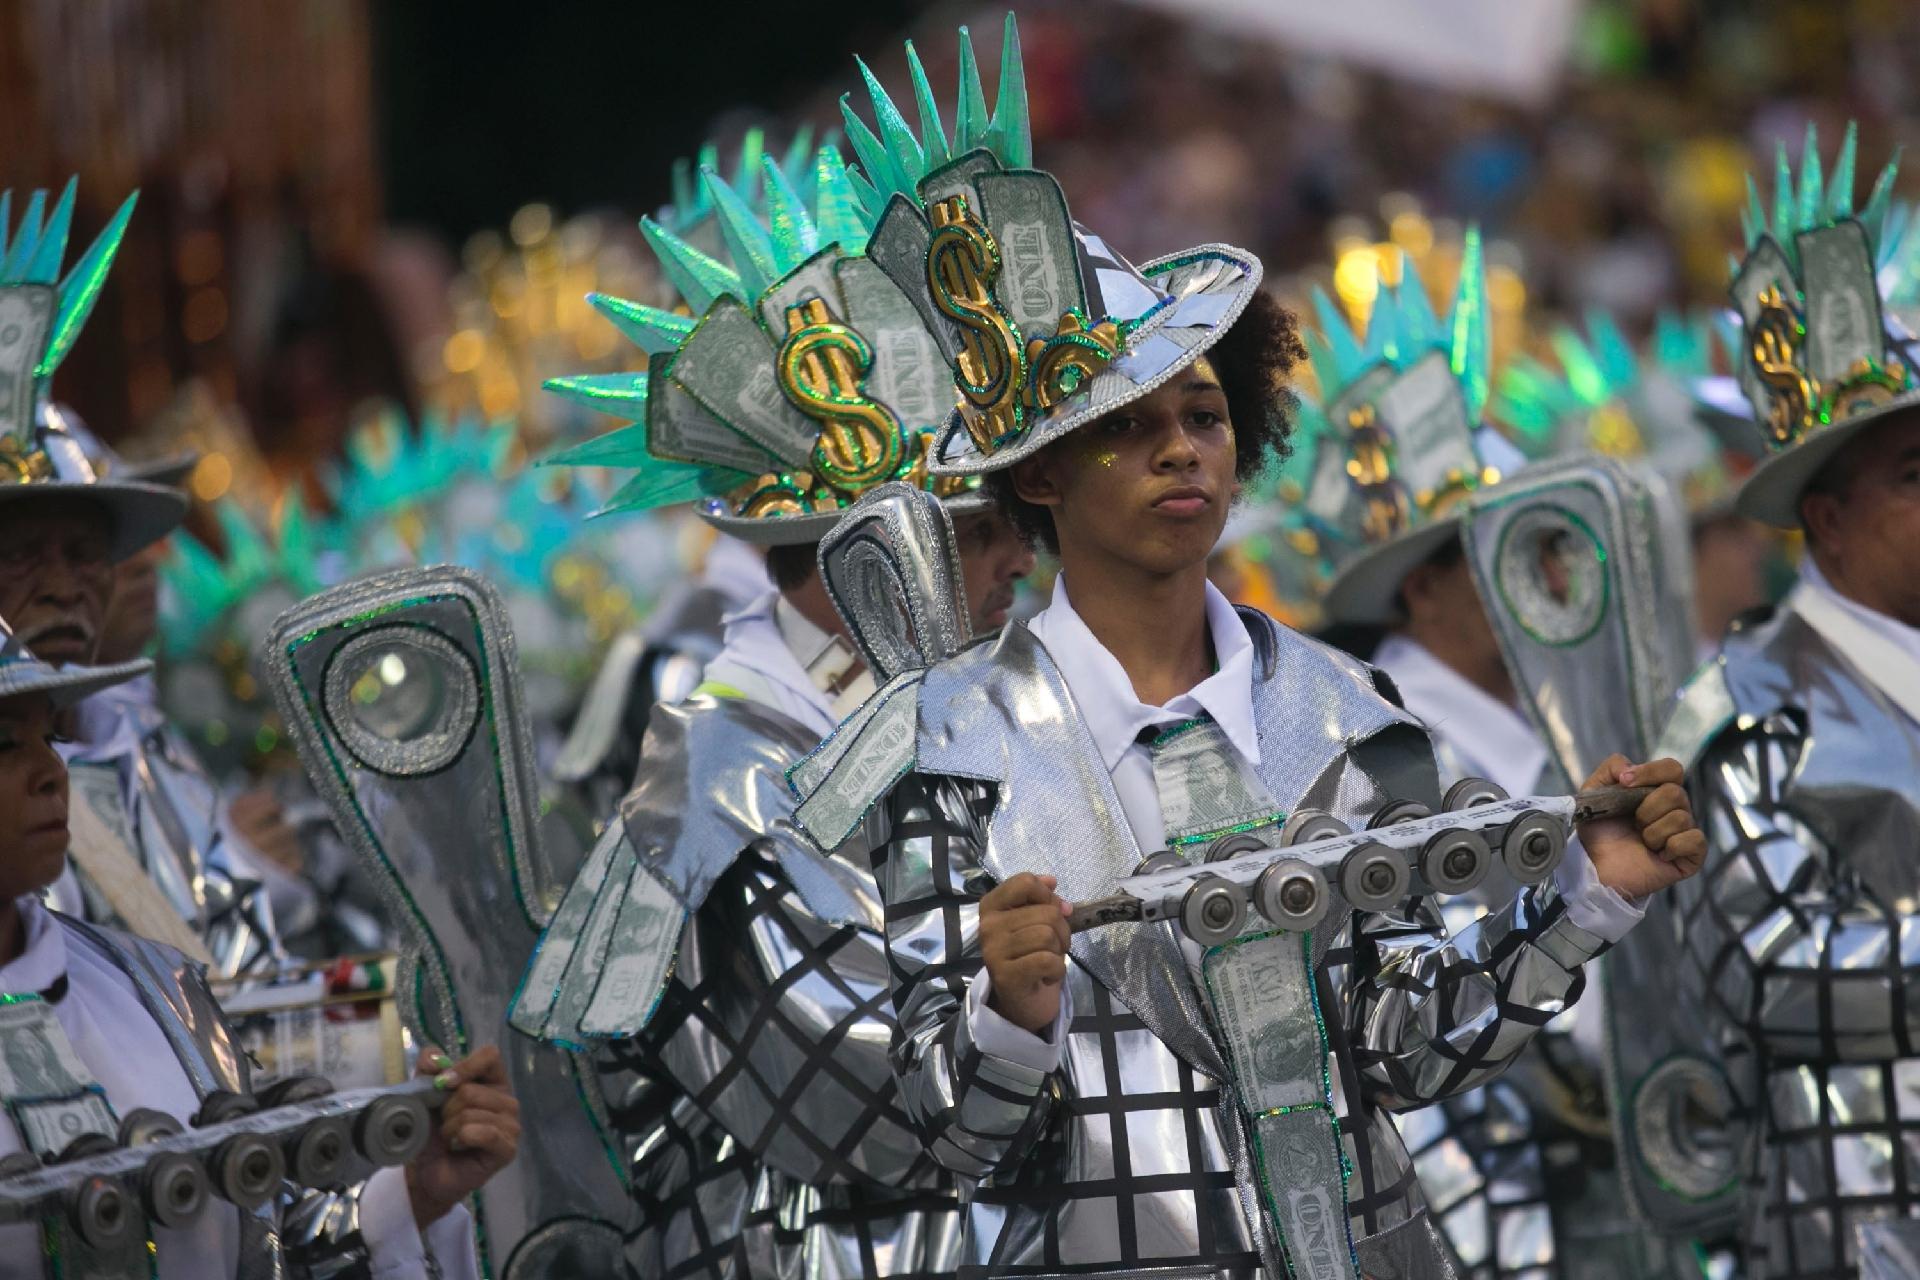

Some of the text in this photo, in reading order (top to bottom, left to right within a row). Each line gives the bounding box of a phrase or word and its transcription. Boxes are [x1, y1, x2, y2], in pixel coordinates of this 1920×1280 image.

[1013, 226, 1053, 318] ONE
[890, 332, 928, 415] ONE
[843, 721, 909, 799] ONE
